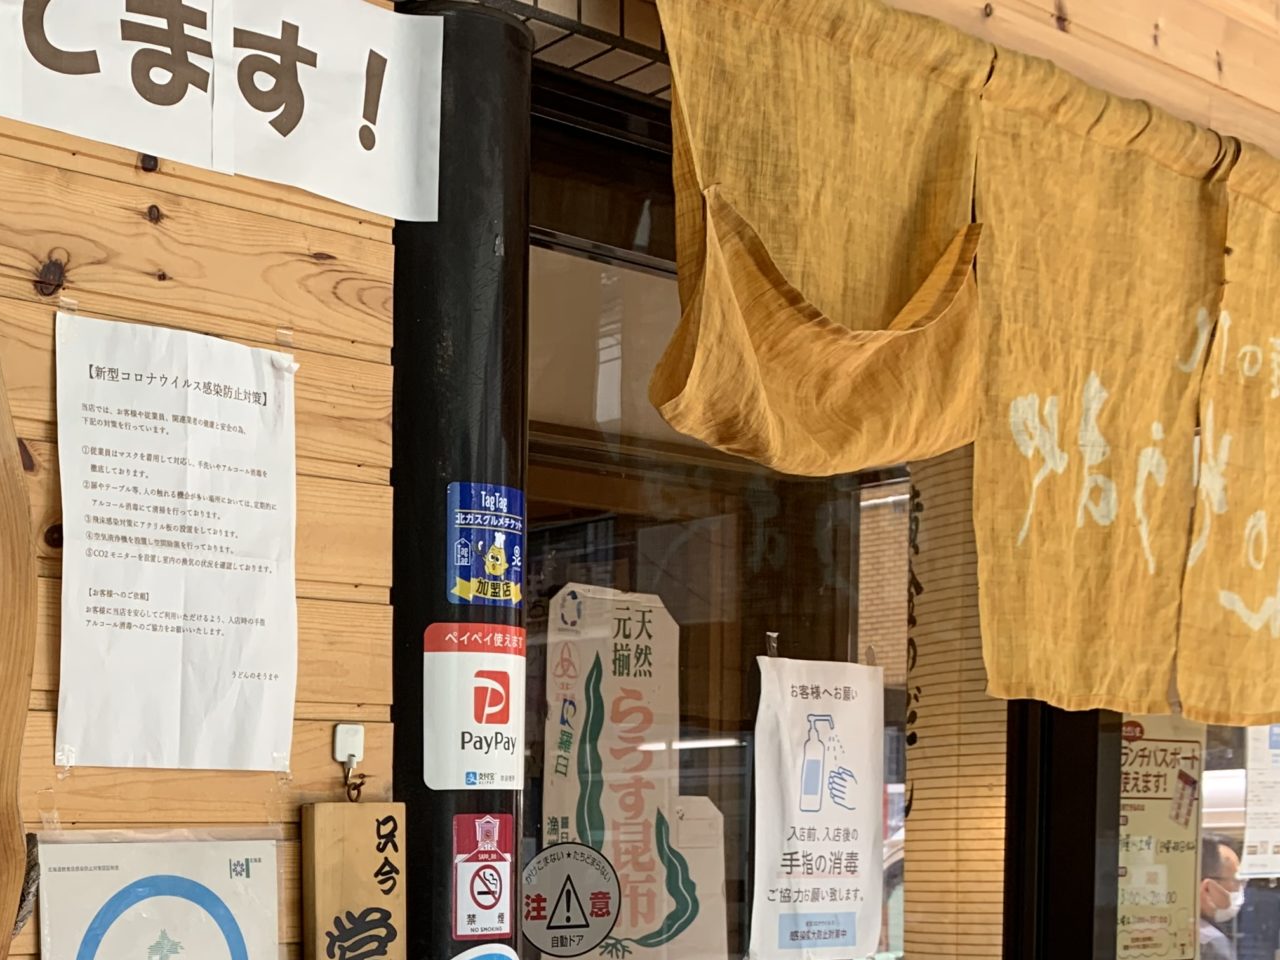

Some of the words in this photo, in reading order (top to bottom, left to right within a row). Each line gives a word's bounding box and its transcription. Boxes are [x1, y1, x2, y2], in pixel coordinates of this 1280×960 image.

[476, 579, 512, 598] 加盟店
[444, 631, 523, 650] ペイペイ使えます
[633, 609, 653, 678] 天然
[790, 683, 859, 702] お客様へお願い
[460, 730, 518, 756] PayPay
[608, 686, 657, 931] らうす昆布
[779, 850, 861, 876] 手指の消毒
[551, 934, 584, 948] 自動ドア
